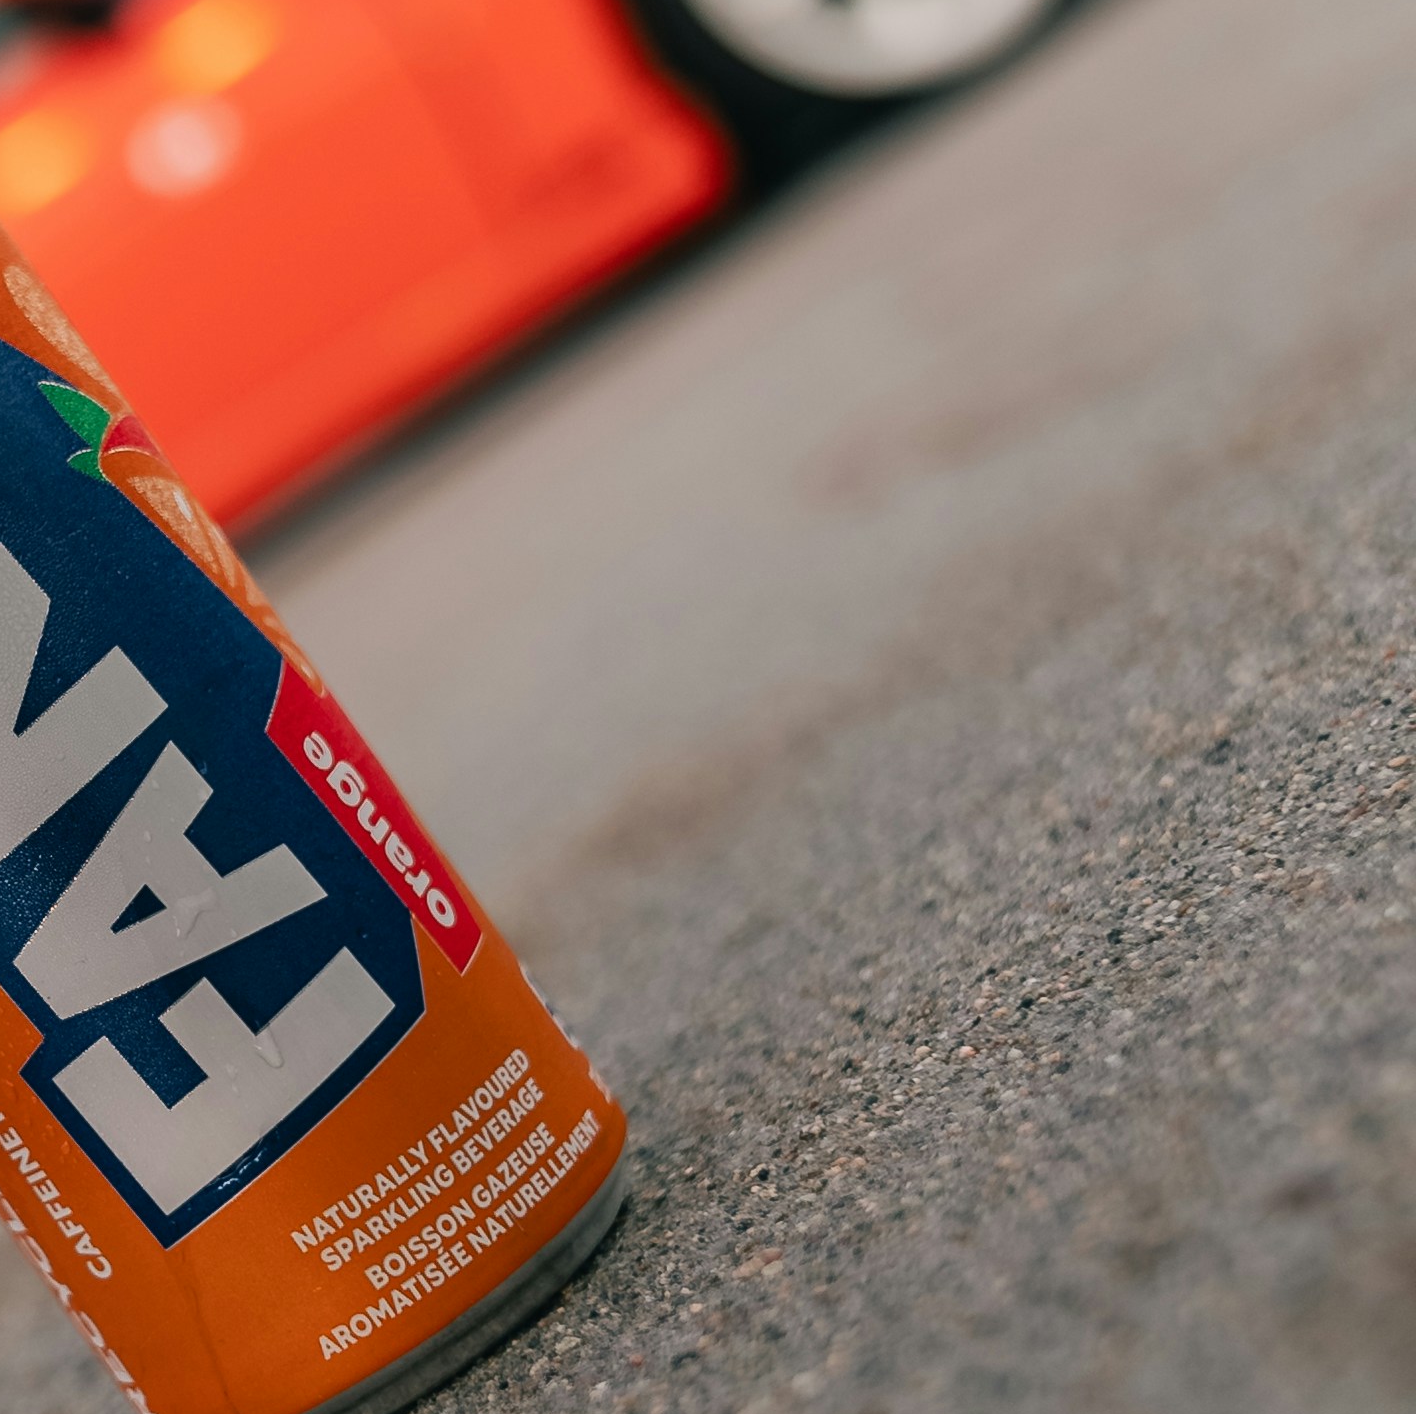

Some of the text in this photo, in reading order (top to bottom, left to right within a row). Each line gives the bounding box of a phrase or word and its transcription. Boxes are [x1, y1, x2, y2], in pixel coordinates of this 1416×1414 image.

[303, 731, 456, 927] orange
[290, 1048, 530, 1253] NATURALLY FLAVOURED
[319, 1109, 601, 1361] AROMATISÉE NATURELLEMENT
[320, 1163, 454, 1271] SPARKLING
[449, 1077, 544, 1175] BEVERAGE
[365, 1121, 555, 1290] BOISSON GAZEUSE
